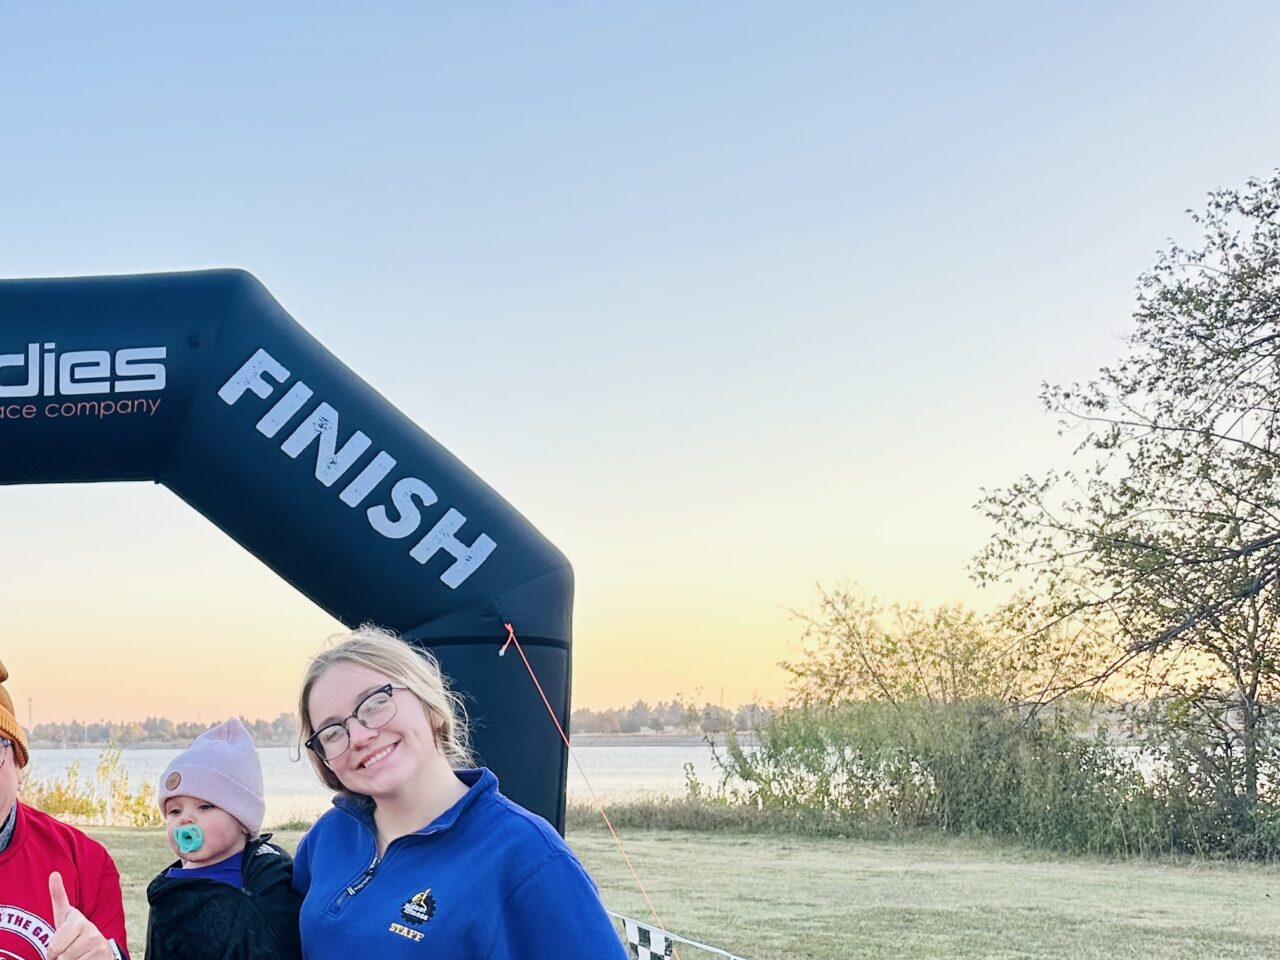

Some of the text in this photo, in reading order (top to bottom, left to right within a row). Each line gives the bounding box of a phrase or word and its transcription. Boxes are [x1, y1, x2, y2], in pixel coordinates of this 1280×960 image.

[45, 397, 162, 420] company
[217, 348, 497, 589] FINISH
[7, 913, 32, 931] THE
[389, 922, 424, 942] STAFF
